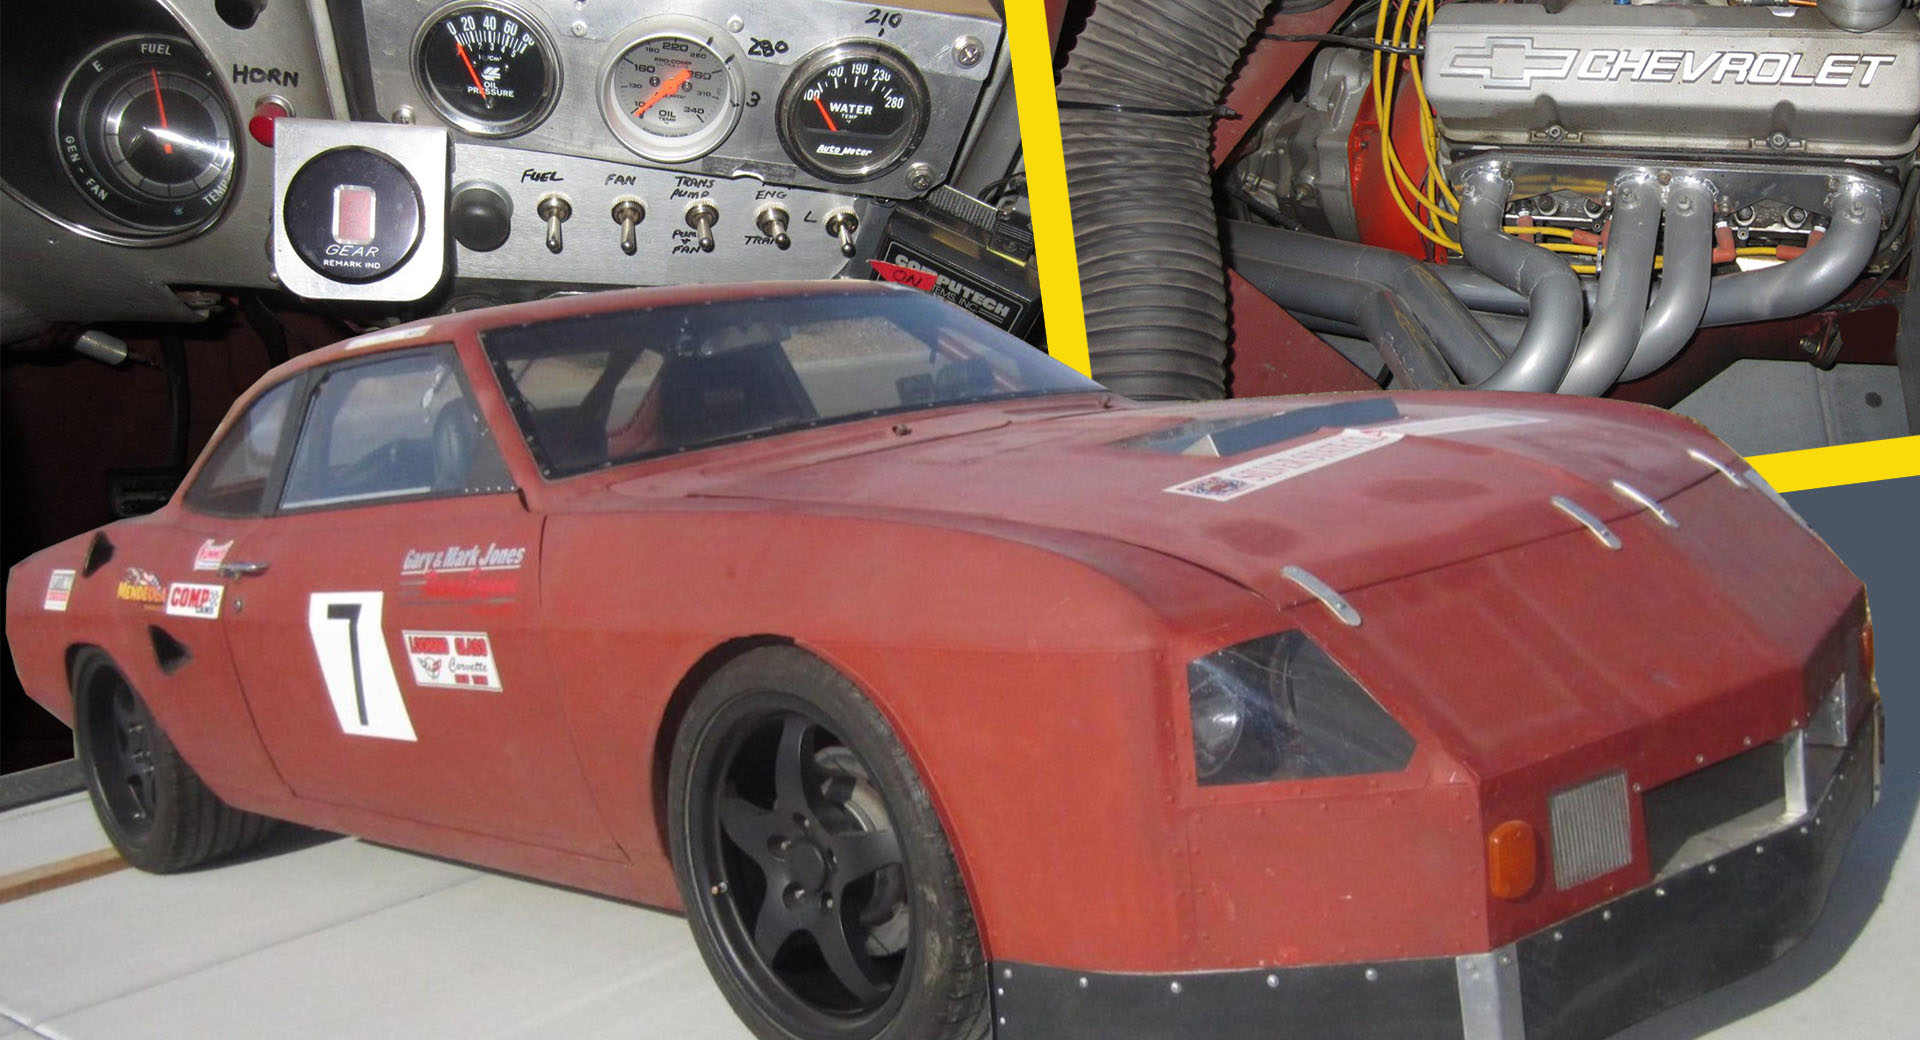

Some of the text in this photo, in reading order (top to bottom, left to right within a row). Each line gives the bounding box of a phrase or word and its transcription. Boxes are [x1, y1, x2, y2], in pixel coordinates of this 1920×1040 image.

[865, 9, 902, 28] 210
[446, 21, 457, 35] 0
[461, 16, 476, 31] 20
[483, 15, 497, 31] 40
[503, 20, 518, 36] 60
[141, 43, 171, 56] FUEL
[662, 42, 688, 52] 220
[748, 37, 789, 57] 280
[92, 60, 104, 73] E
[634, 63, 655, 74] 160
[852, 63, 868, 75] 190
[1577, 50, 1897, 87] CHEVROLET
[232, 64, 299, 87] HORN
[484, 81, 498, 90] OIL
[829, 102, 873, 115] WATER
[885, 96, 904, 109] 280
[659, 109, 676, 118] OIL
[683, 106, 704, 115] 340
[521, 169, 564, 183] FUEL
[605, 174, 637, 186] FAN
[675, 176, 715, 188] TRANS
[86, 178, 109, 200] FAN
[755, 190, 787, 200] ENG
[672, 229, 697, 239] PUM
[325, 244, 379, 258] GEAR
[672, 245, 700, 254] FAN
[323, 259, 380, 269] REMARK IND
[892, 270, 922, 287] ON
[402, 548, 433, 574] Gary
[443, 545, 480, 568] Mark
[479, 542, 525, 566] Jones
[171, 587, 210, 608] COMP
[327, 603, 369, 726] 7
[448, 656, 488, 673] Corvette
